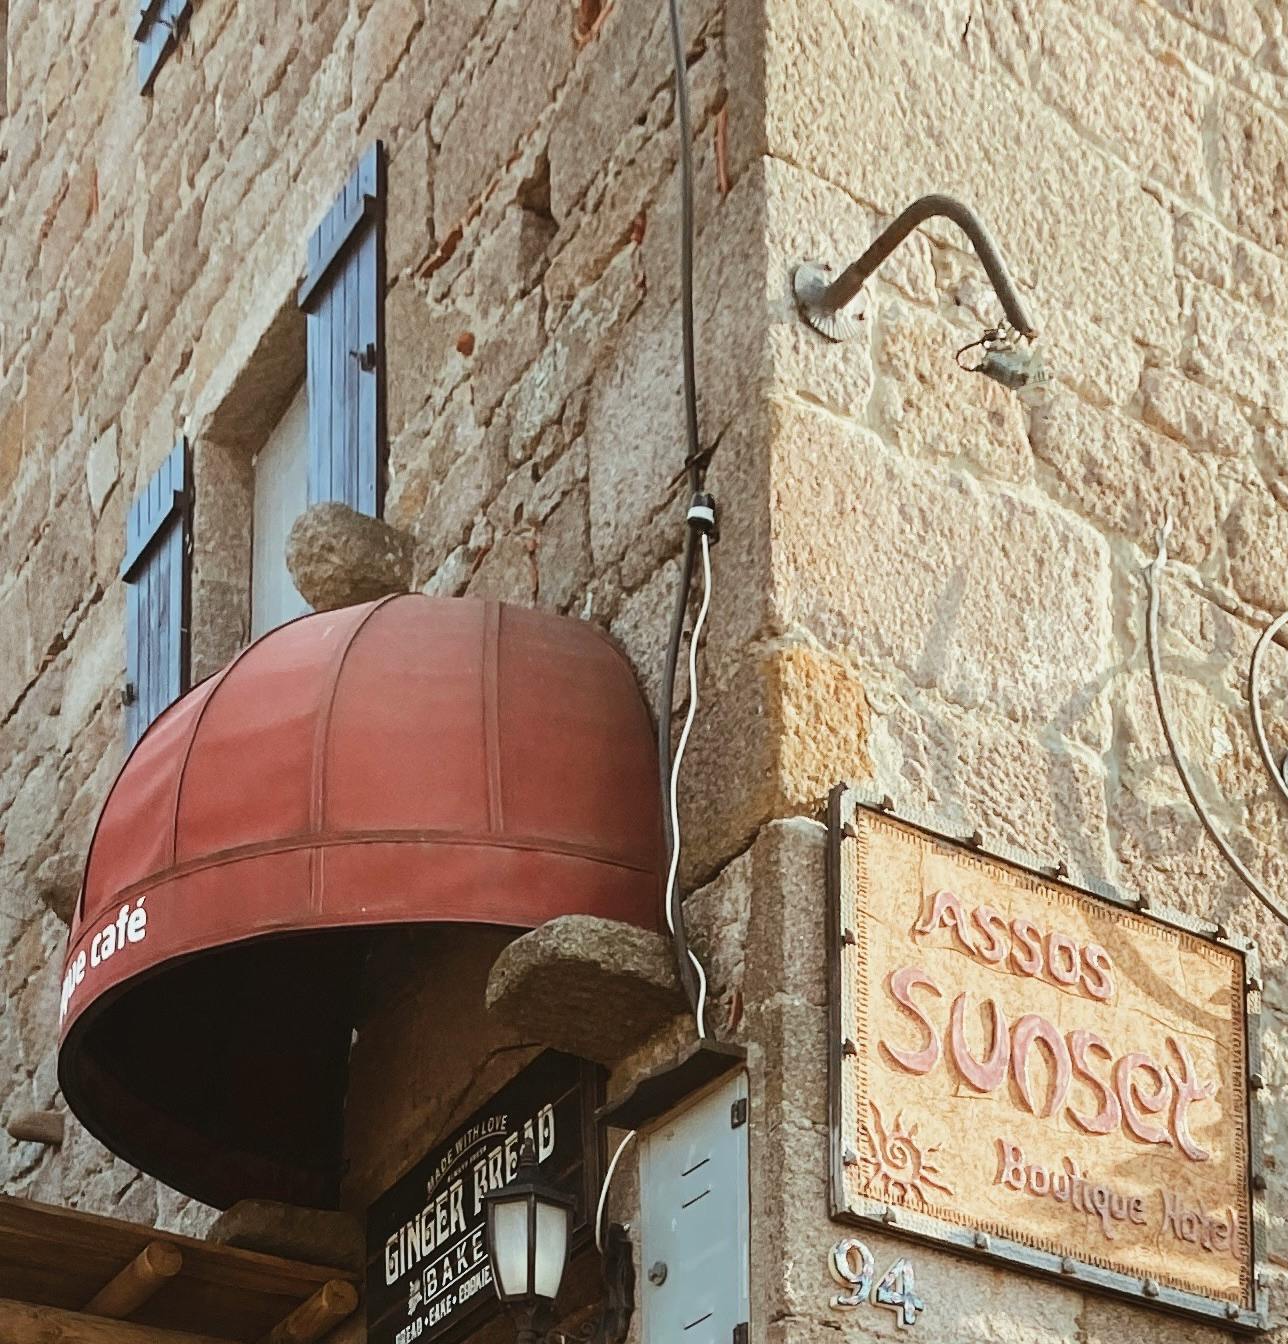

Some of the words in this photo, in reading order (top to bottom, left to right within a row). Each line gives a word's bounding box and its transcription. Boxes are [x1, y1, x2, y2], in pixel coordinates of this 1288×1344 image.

[90, 895, 147, 969] café
[913, 889, 1118, 1002] ASSOS
[455, 1124, 480, 1154] WITH
[481, 1114, 508, 1136] LOVE
[385, 1178, 467, 1286] GINGER
[993, 1138, 1148, 1241] Boutique
[1157, 1187, 1243, 1261] Hotel
[427, 1230, 484, 1298] BAKE
[458, 1264, 493, 1305] COOKIE
[829, 1237, 924, 1328] 94
